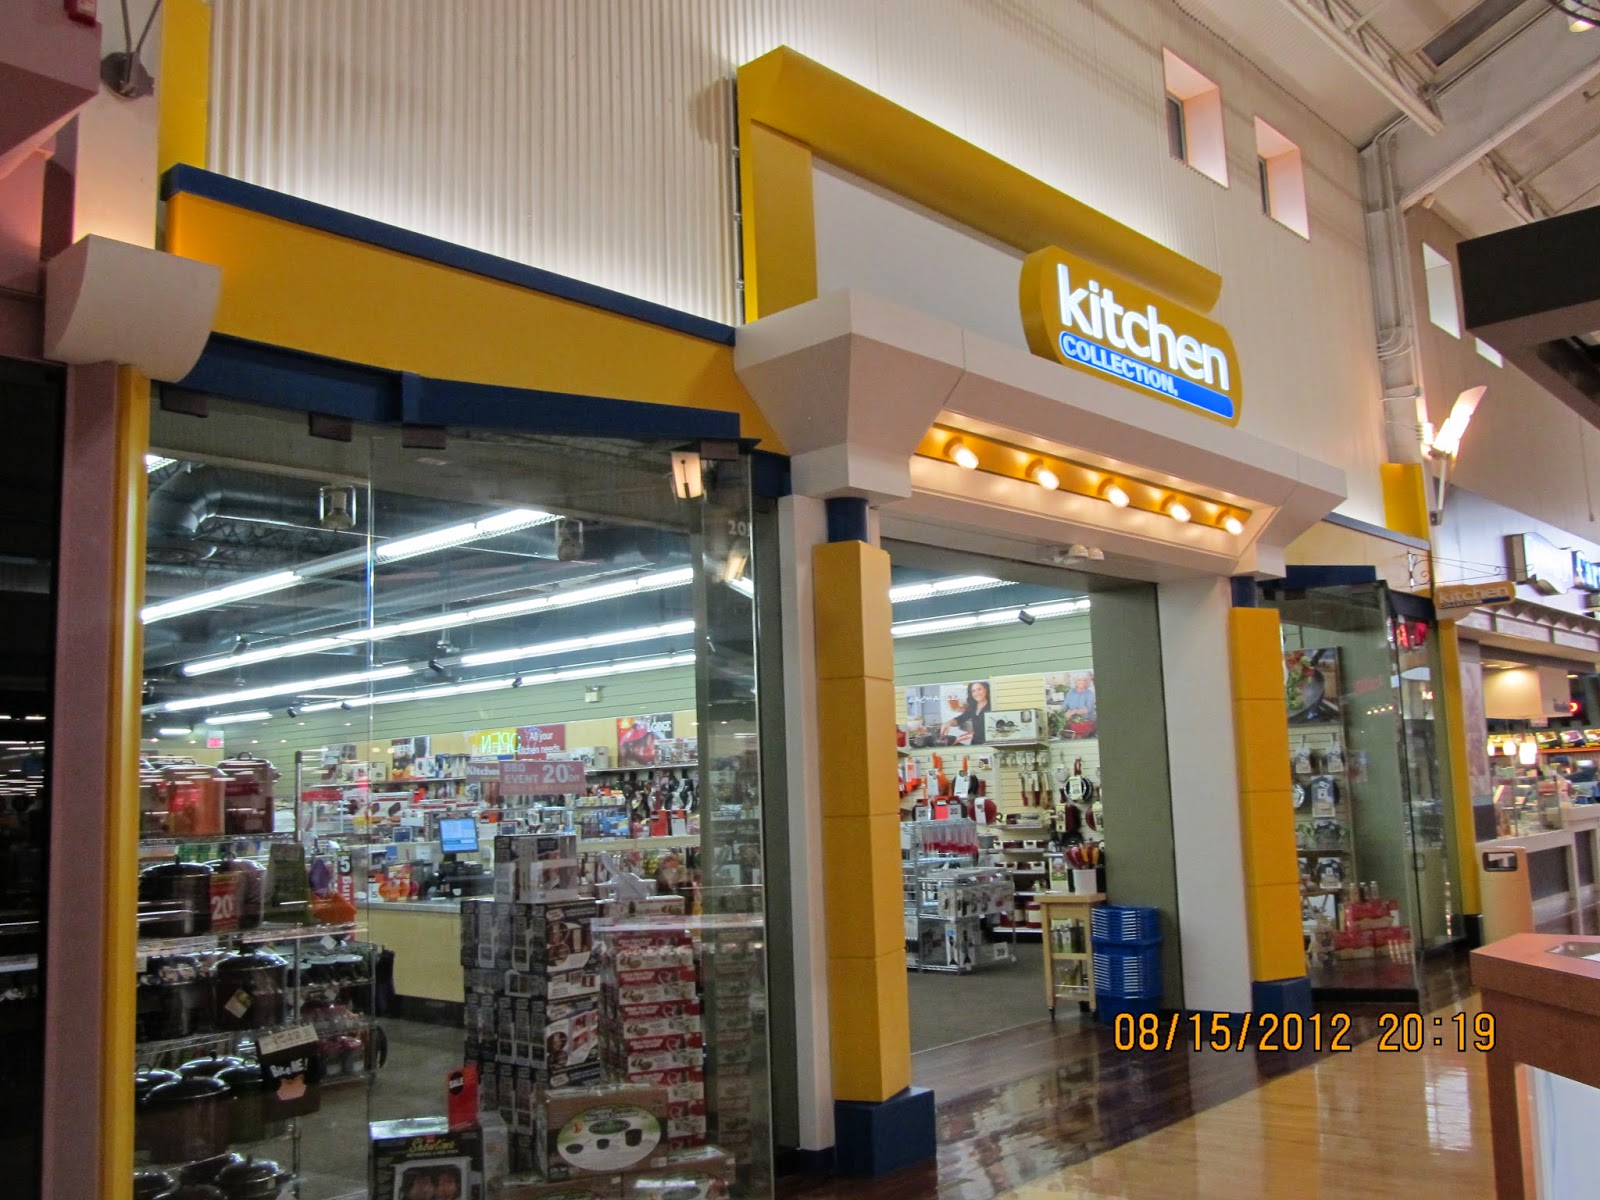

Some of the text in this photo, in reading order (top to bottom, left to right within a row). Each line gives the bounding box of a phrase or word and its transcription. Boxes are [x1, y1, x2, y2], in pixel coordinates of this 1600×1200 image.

[1057, 263, 1230, 391] kitchen
[1439, 587, 1509, 602] kitchen
[539, 731, 554, 742] your
[504, 774, 539, 784] EVENT
[211, 895, 233, 920] 20
[449, 1077, 464, 1089] SALE
